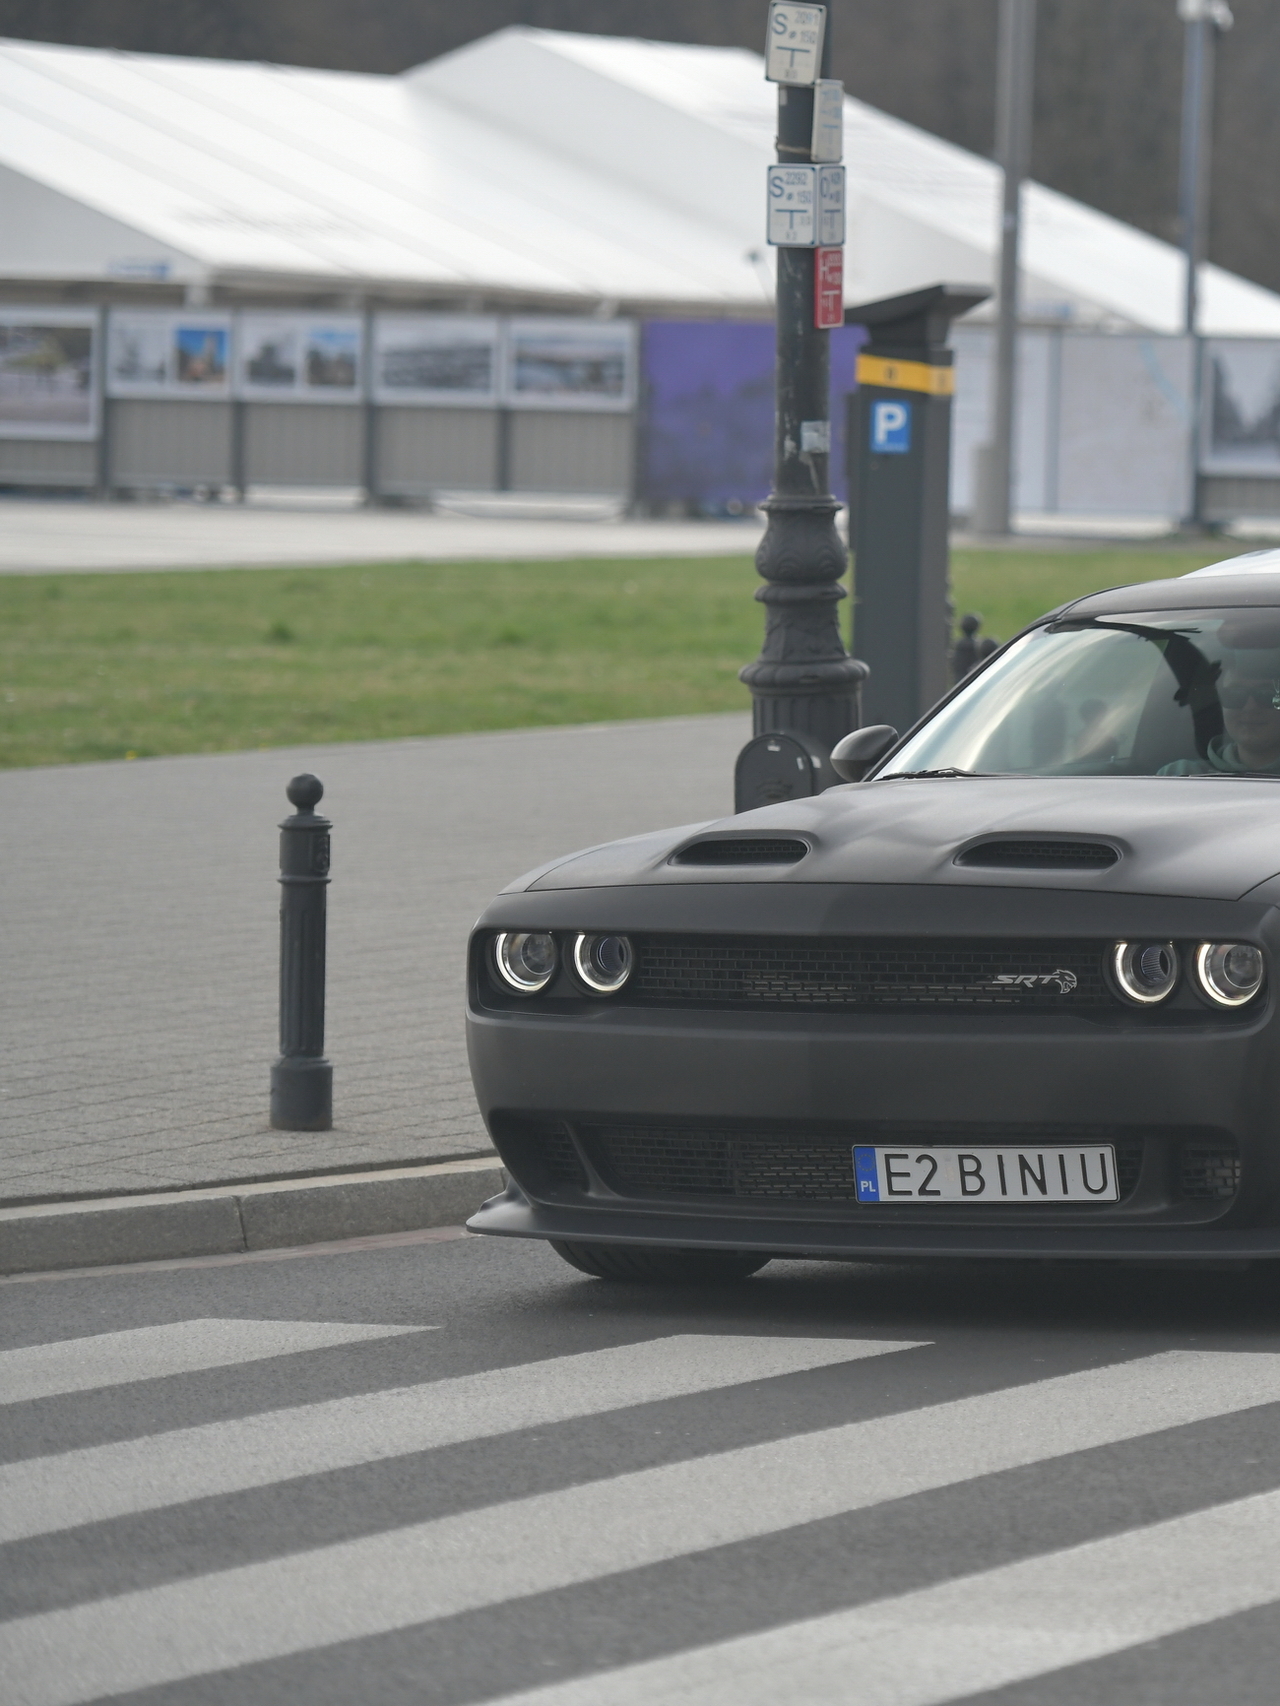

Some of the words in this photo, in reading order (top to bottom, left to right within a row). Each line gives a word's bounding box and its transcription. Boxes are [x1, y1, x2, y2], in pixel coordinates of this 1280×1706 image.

[772, 13, 788, 35] S
[770, 175, 785, 198] S
[874, 402, 908, 445] P
[992, 975, 1060, 988] SRT
[884, 1153, 941, 1196] E2
[957, 1153, 1108, 1196] BINIU
[860, 1181, 876, 1192] PL
